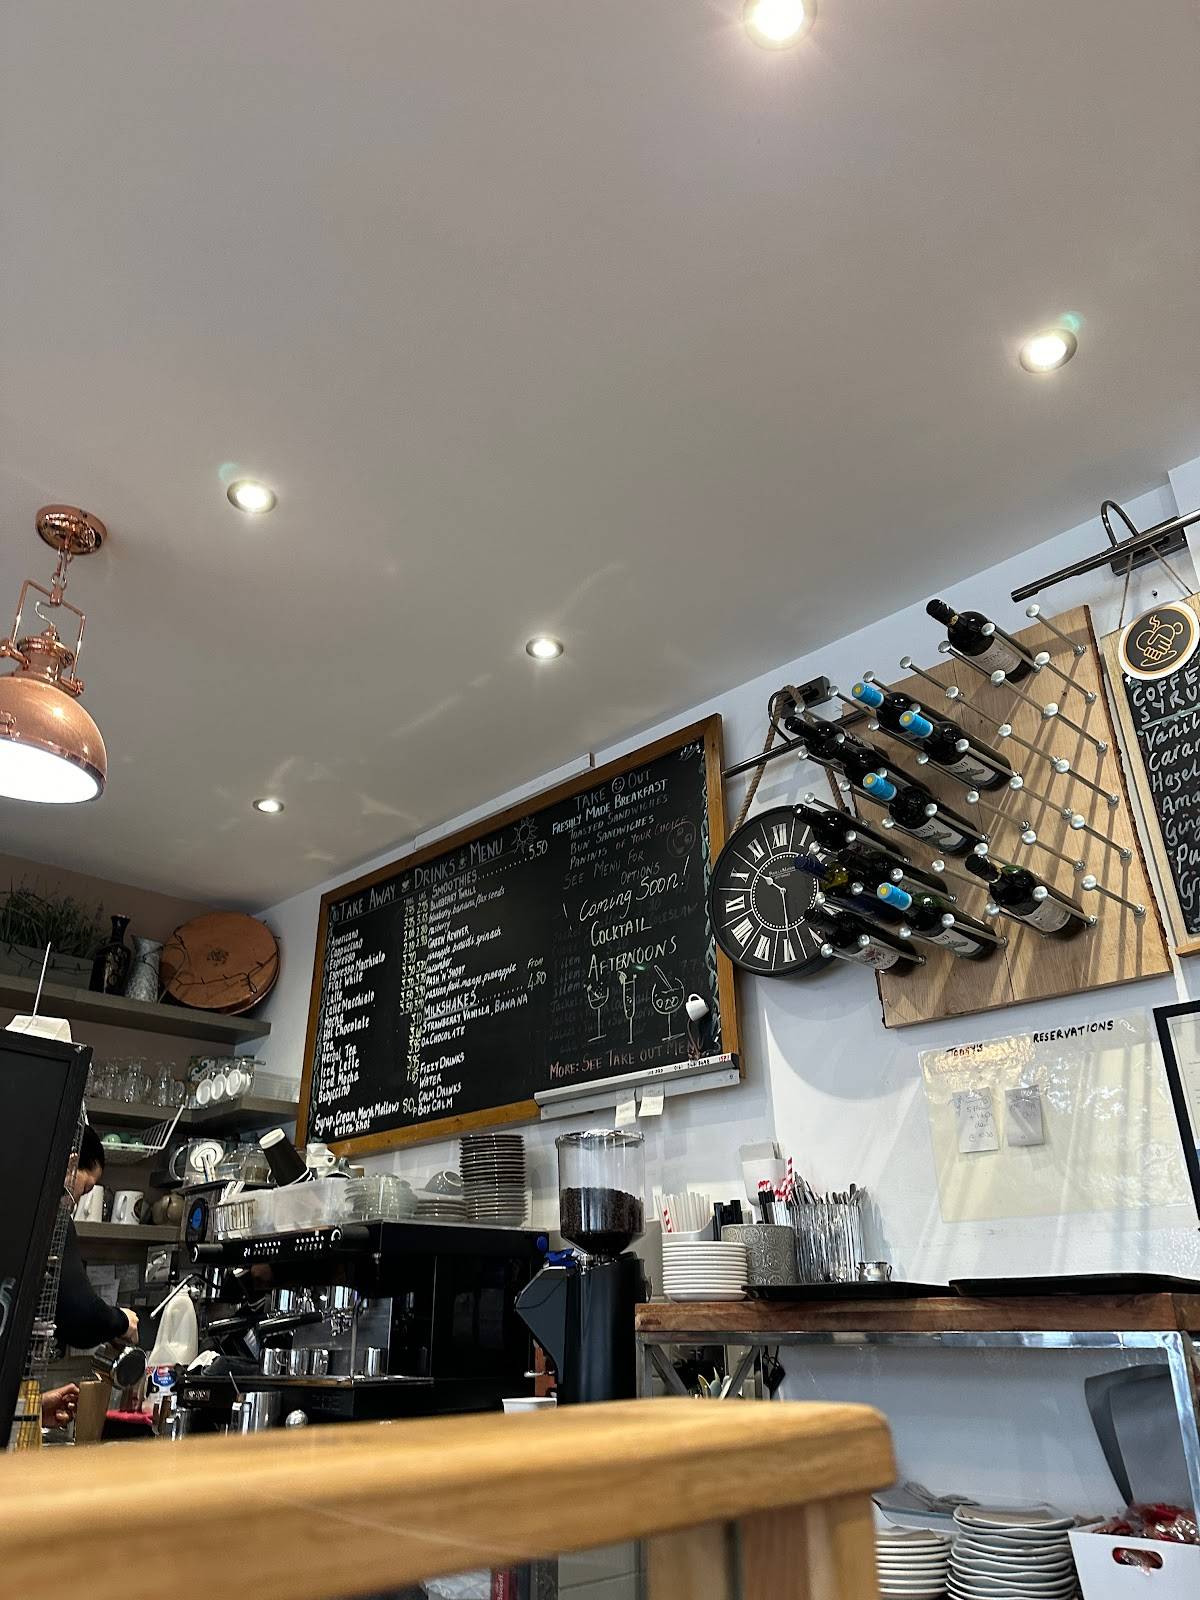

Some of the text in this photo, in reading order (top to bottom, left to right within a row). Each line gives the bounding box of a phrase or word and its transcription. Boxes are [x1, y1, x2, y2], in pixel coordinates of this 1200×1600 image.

[574, 771, 651, 811] TAKE OUT
[586, 804, 611, 822] MADE
[614, 779, 669, 809] BREAKFAST
[569, 822, 604, 841] TOASTED
[570, 814, 655, 855] BUN SANDWICHES
[340, 899, 364, 921] TAKE
[369, 884, 396, 909] AWAY
[414, 859, 456, 889] DRINKS
[469, 837, 503, 866] MENU
[432, 870, 477, 898] SMOOTHIES
[528, 840, 548, 860] 5.50
[562, 872, 585, 890] SEE
[593, 857, 621, 879] MENU
[591, 917, 652, 947] COCKTAIL
[588, 935, 677, 982] AFTERNOONS
[323, 1040, 334, 1052] Tea
[1032, 1019, 1115, 1044] RESERVATIONS
[345, 1043, 357, 1057] Tea
[581, 1055, 602, 1072] SEE
[608, 1050, 635, 1067] TAKE
[640, 1044, 663, 1062] OUT
[419, 1072, 442, 1089] WATER
